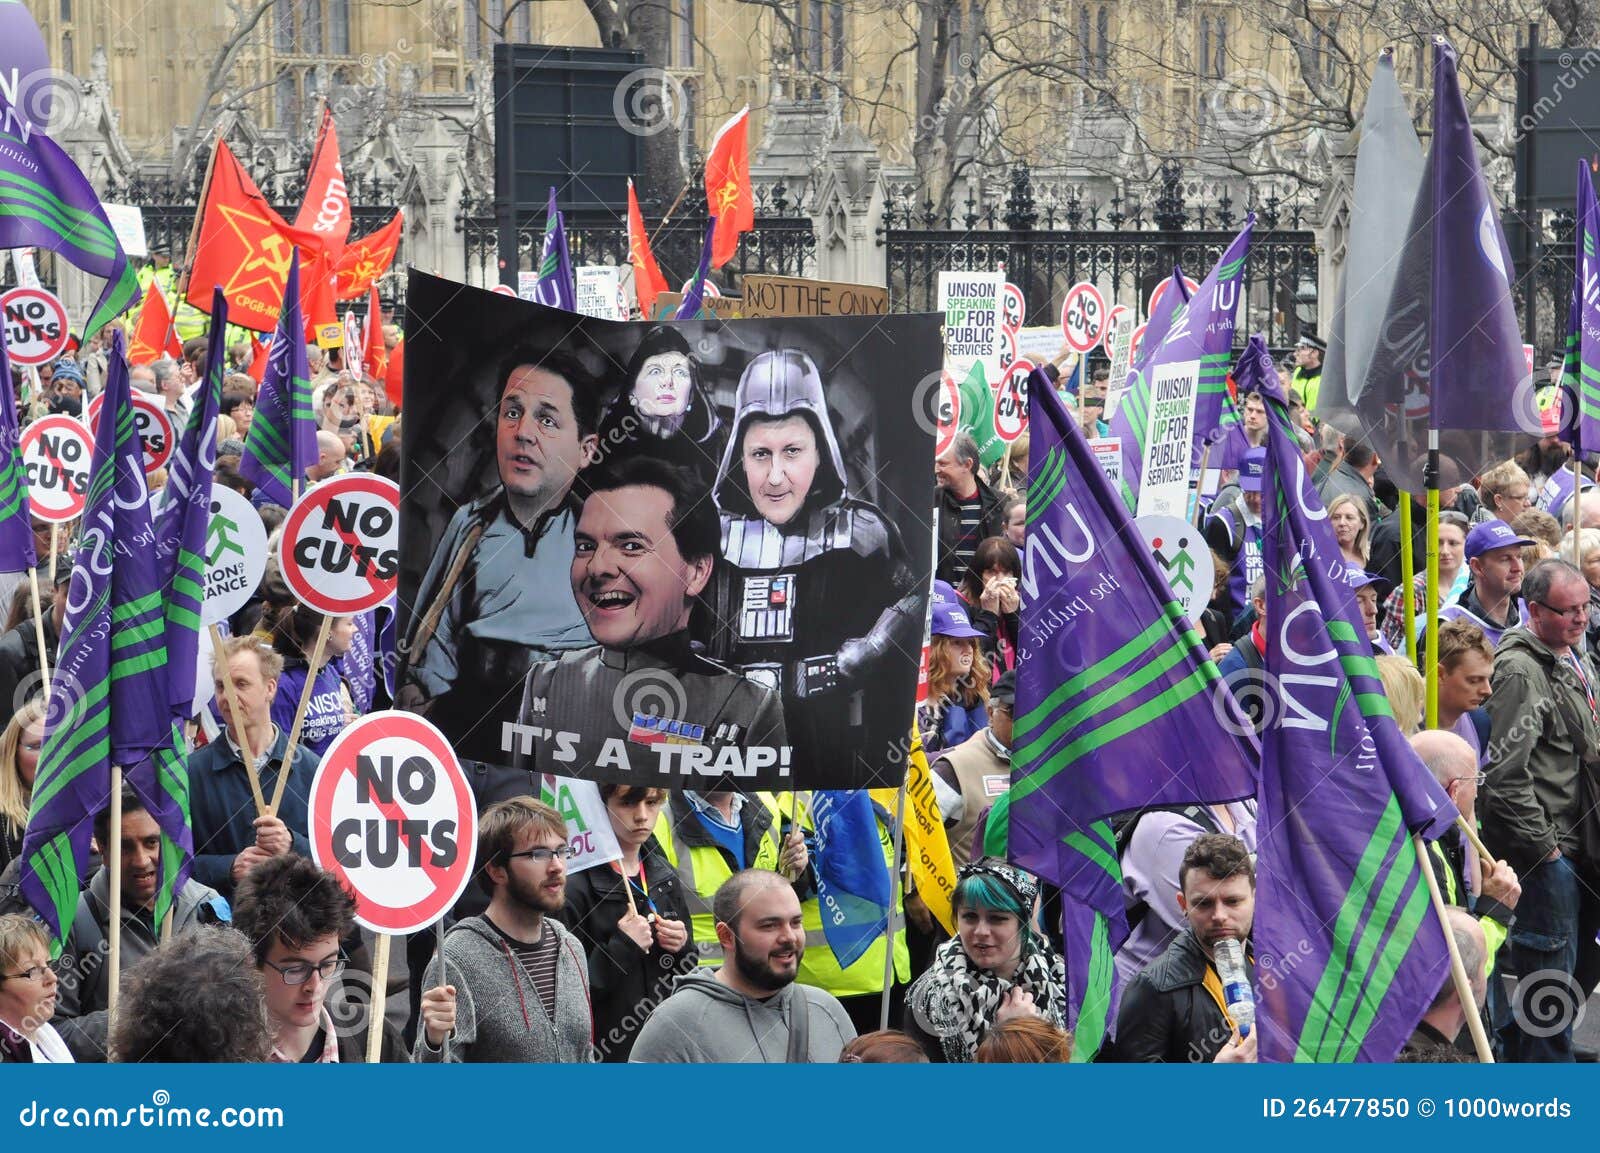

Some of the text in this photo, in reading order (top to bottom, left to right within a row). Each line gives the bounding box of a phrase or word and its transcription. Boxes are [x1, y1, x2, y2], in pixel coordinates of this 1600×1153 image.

[792, 285, 831, 315] THE
[838, 290, 884, 315] ONLY
[946, 298, 996, 310] SPEAKING
[947, 282, 996, 298] UNISON
[1077, 292, 1097, 317] NO
[5, 301, 46, 322] NO
[946, 310, 995, 327] UP FOR
[1066, 309, 1099, 340] CUTS
[946, 343, 993, 356] SERVICES
[947, 327, 994, 344] PUBLIC
[1156, 376, 1193, 402] UNISON
[1154, 398, 1190, 420] SPEAKING
[1152, 415, 1189, 445] UP FOR
[37, 432, 82, 463] NO
[1149, 440, 1187, 469] PUBLIC
[25, 462, 88, 498] CUTS
[1147, 464, 1184, 487] SERVICES
[321, 498, 393, 537] NO
[293, 536, 399, 582] CUTS
[501, 721, 793, 777] IT'S A TRAP!
[356, 755, 436, 806] NO
[331, 817, 458, 869] CUTS
